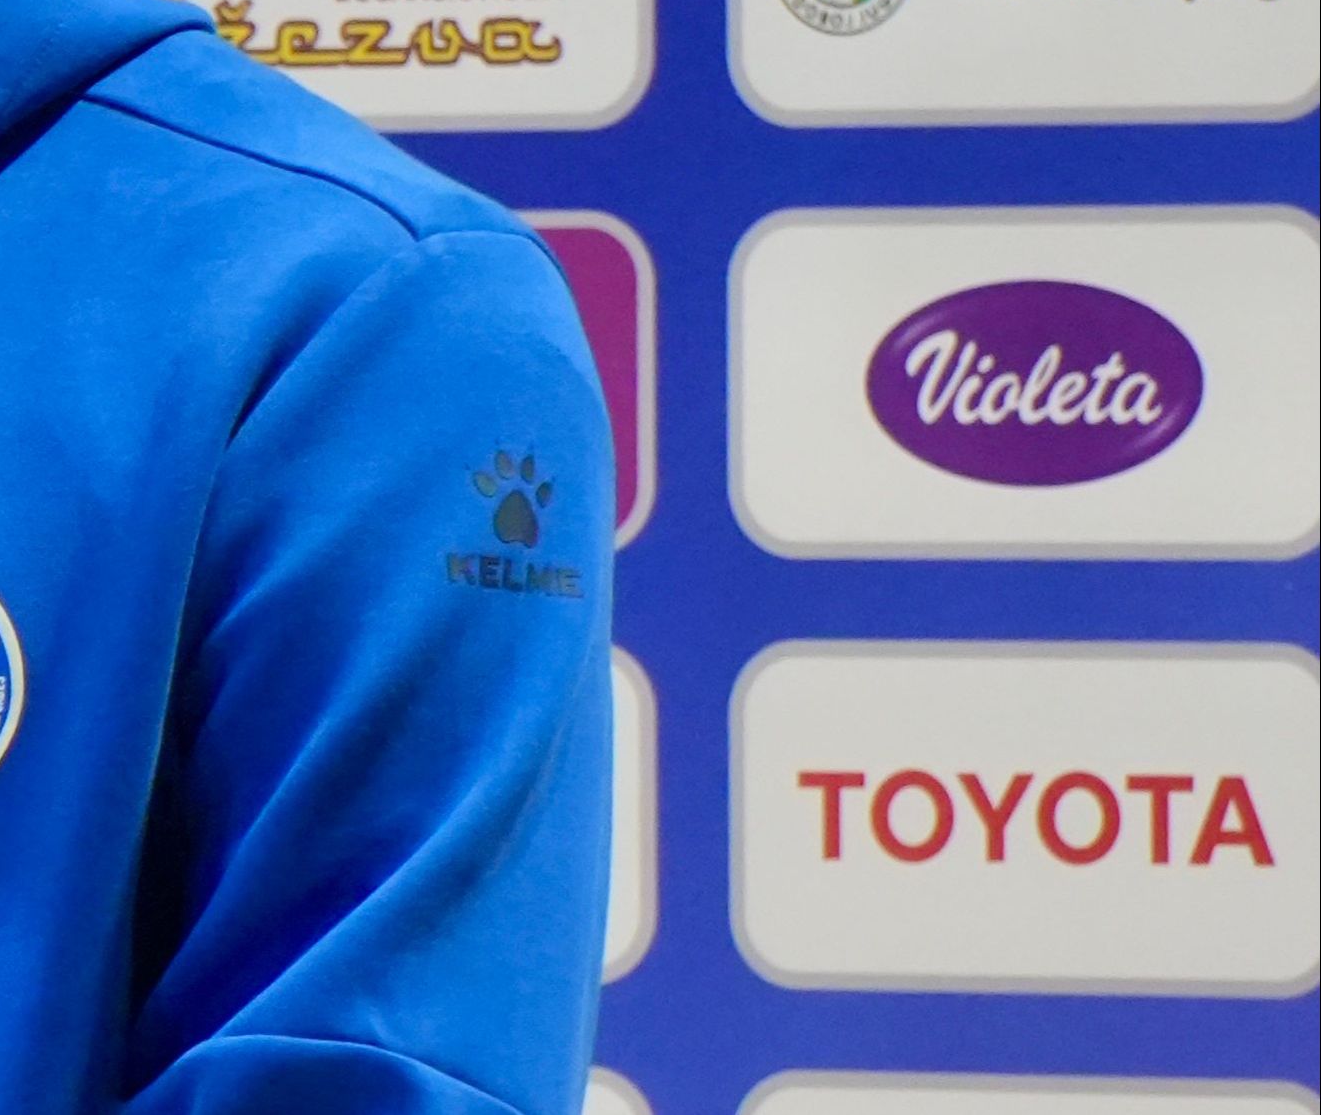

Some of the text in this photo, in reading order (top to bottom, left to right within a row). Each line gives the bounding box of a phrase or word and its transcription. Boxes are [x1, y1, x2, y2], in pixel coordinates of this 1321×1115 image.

[905, 329, 1164, 425] Violeta
[445, 552, 584, 598] KELME
[797, 768, 1276, 868] TOYOTA
